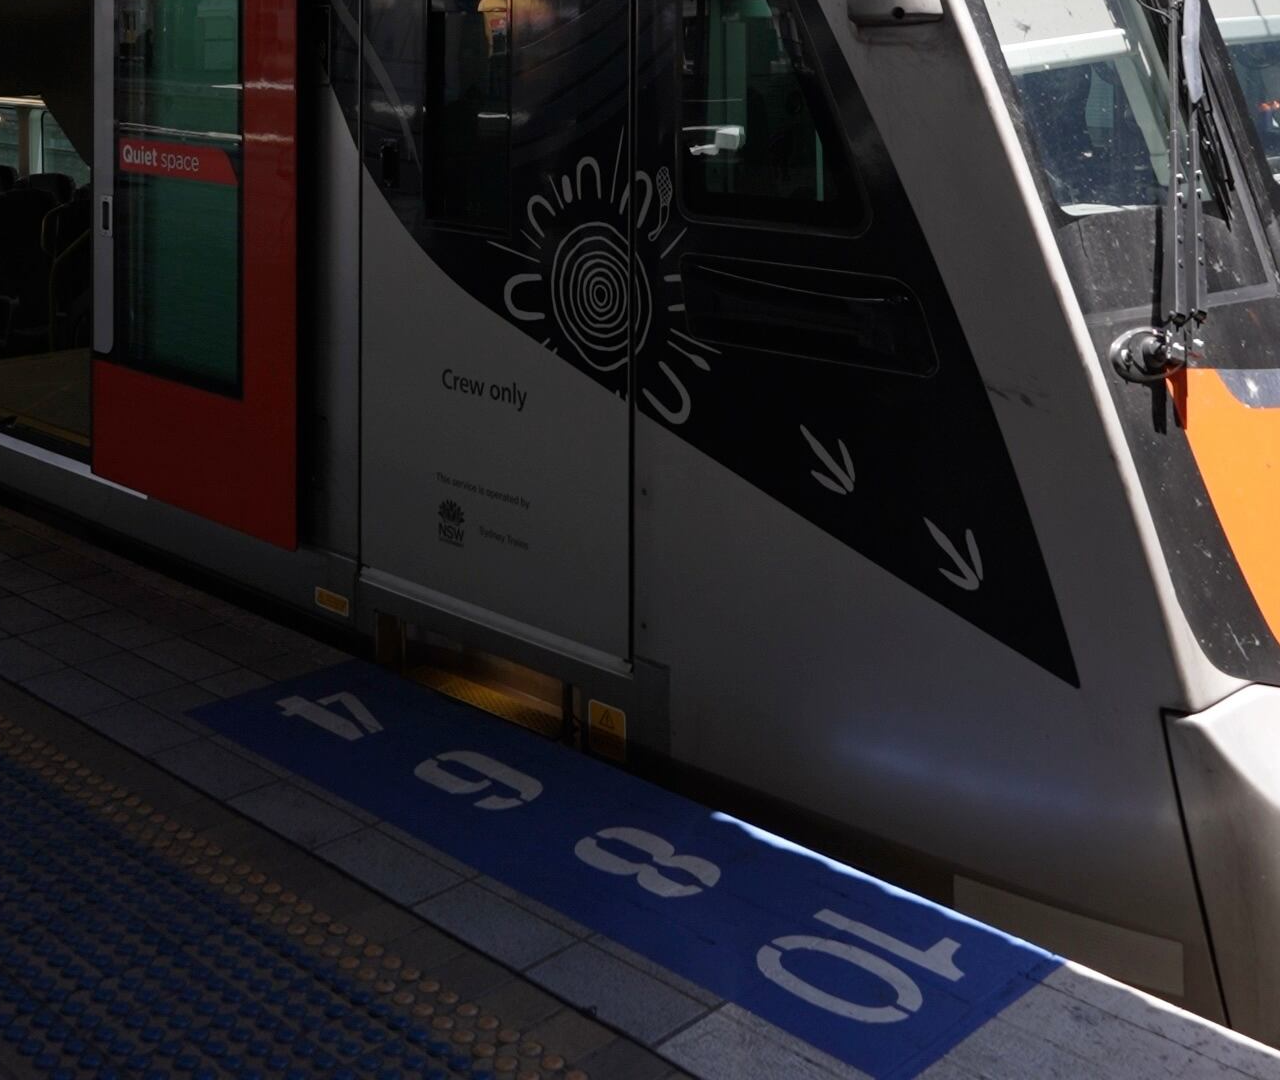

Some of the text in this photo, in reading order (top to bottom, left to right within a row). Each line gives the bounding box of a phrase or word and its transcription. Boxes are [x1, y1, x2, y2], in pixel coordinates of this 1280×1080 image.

[122, 144, 200, 172] Quiet space
[441, 368, 527, 412] Crew only
[438, 522, 465, 542] NSW
[274, 691, 384, 742] 4
[413, 749, 544, 810] 6
[574, 826, 721, 898] 8
[755, 907, 965, 1023] 10
